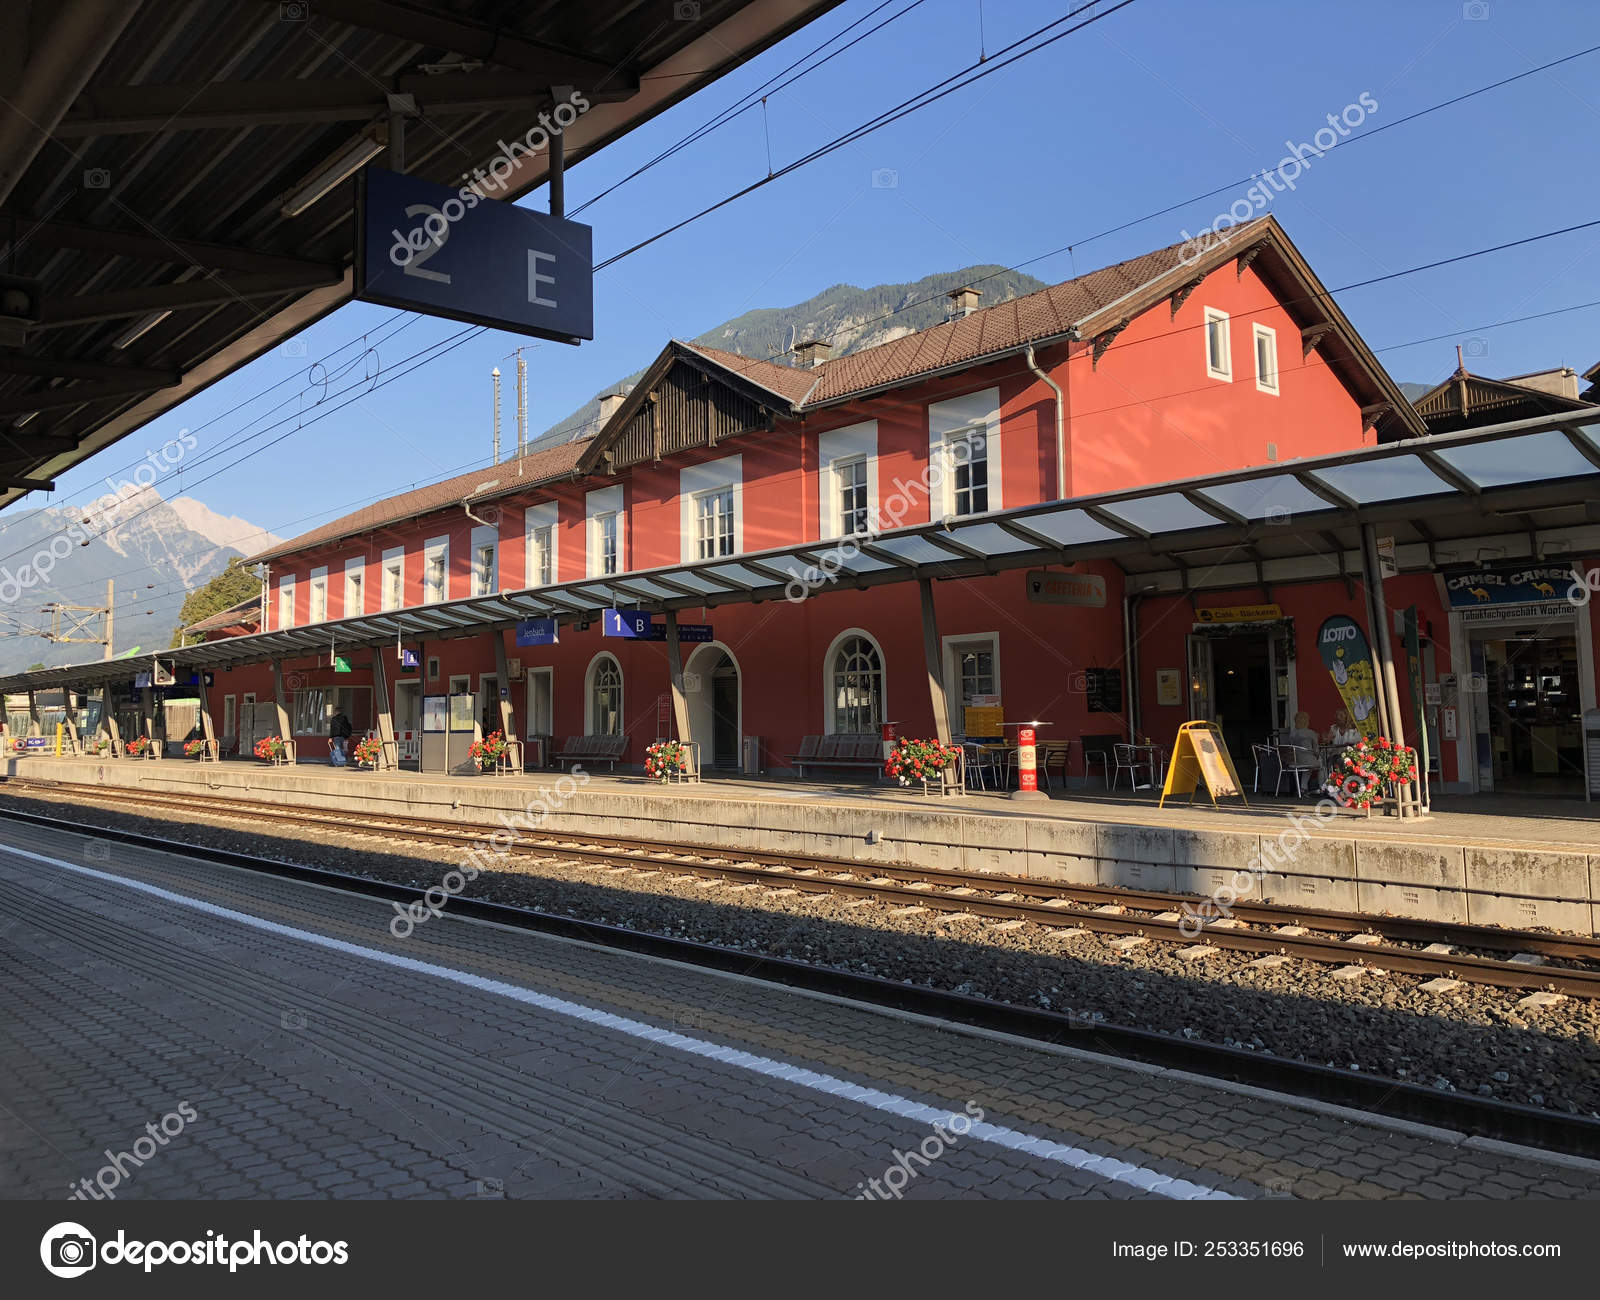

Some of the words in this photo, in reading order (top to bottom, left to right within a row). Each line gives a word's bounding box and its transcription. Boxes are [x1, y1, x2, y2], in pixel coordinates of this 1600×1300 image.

[403, 203, 451, 284] 2
[527, 248, 557, 308] E
[1447, 574, 1506, 590] CAMEL
[1509, 568, 1572, 585] CAMEL
[613, 613, 622, 632] 1
[636, 618, 645, 633] B
[1321, 625, 1357, 643] LOTTO
